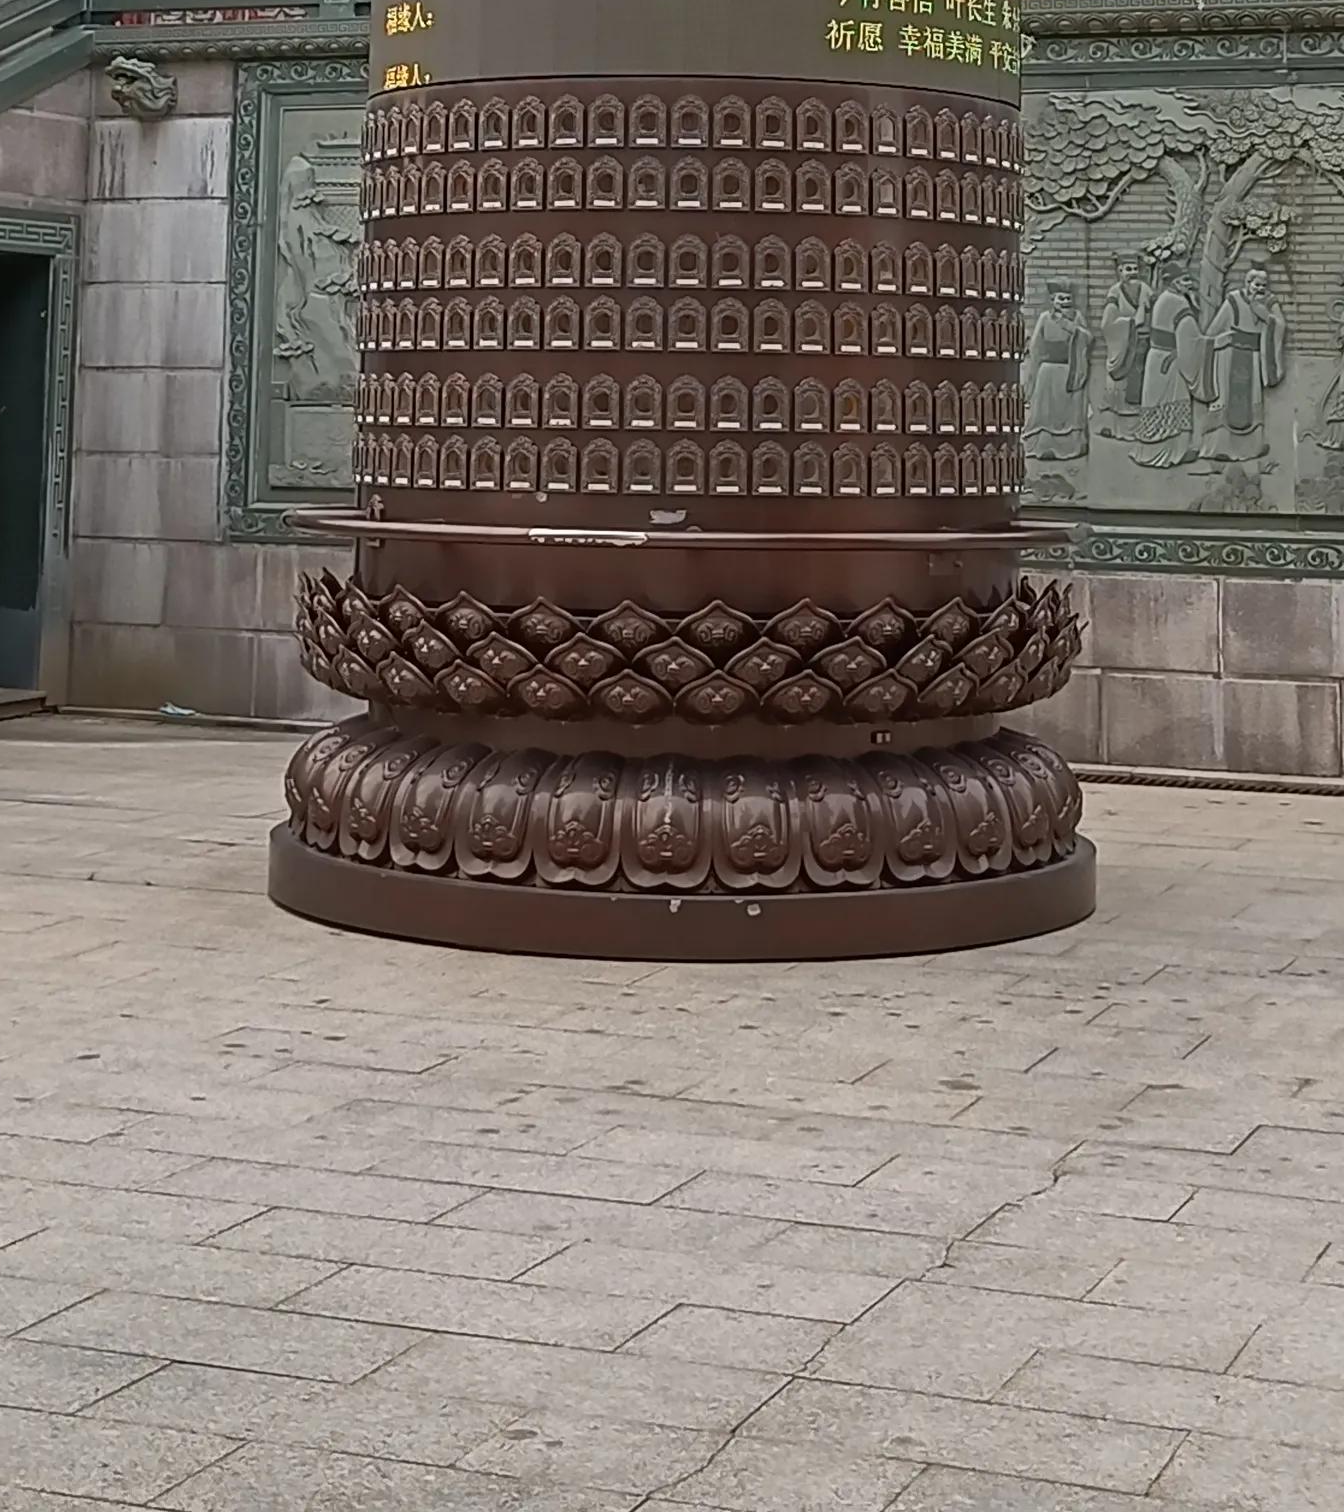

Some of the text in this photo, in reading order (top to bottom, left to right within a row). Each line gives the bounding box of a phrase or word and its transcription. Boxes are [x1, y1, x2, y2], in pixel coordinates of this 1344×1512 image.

[825, 20, 884, 51] 祈愿
[898, 25, 983, 66] 幸福美满
